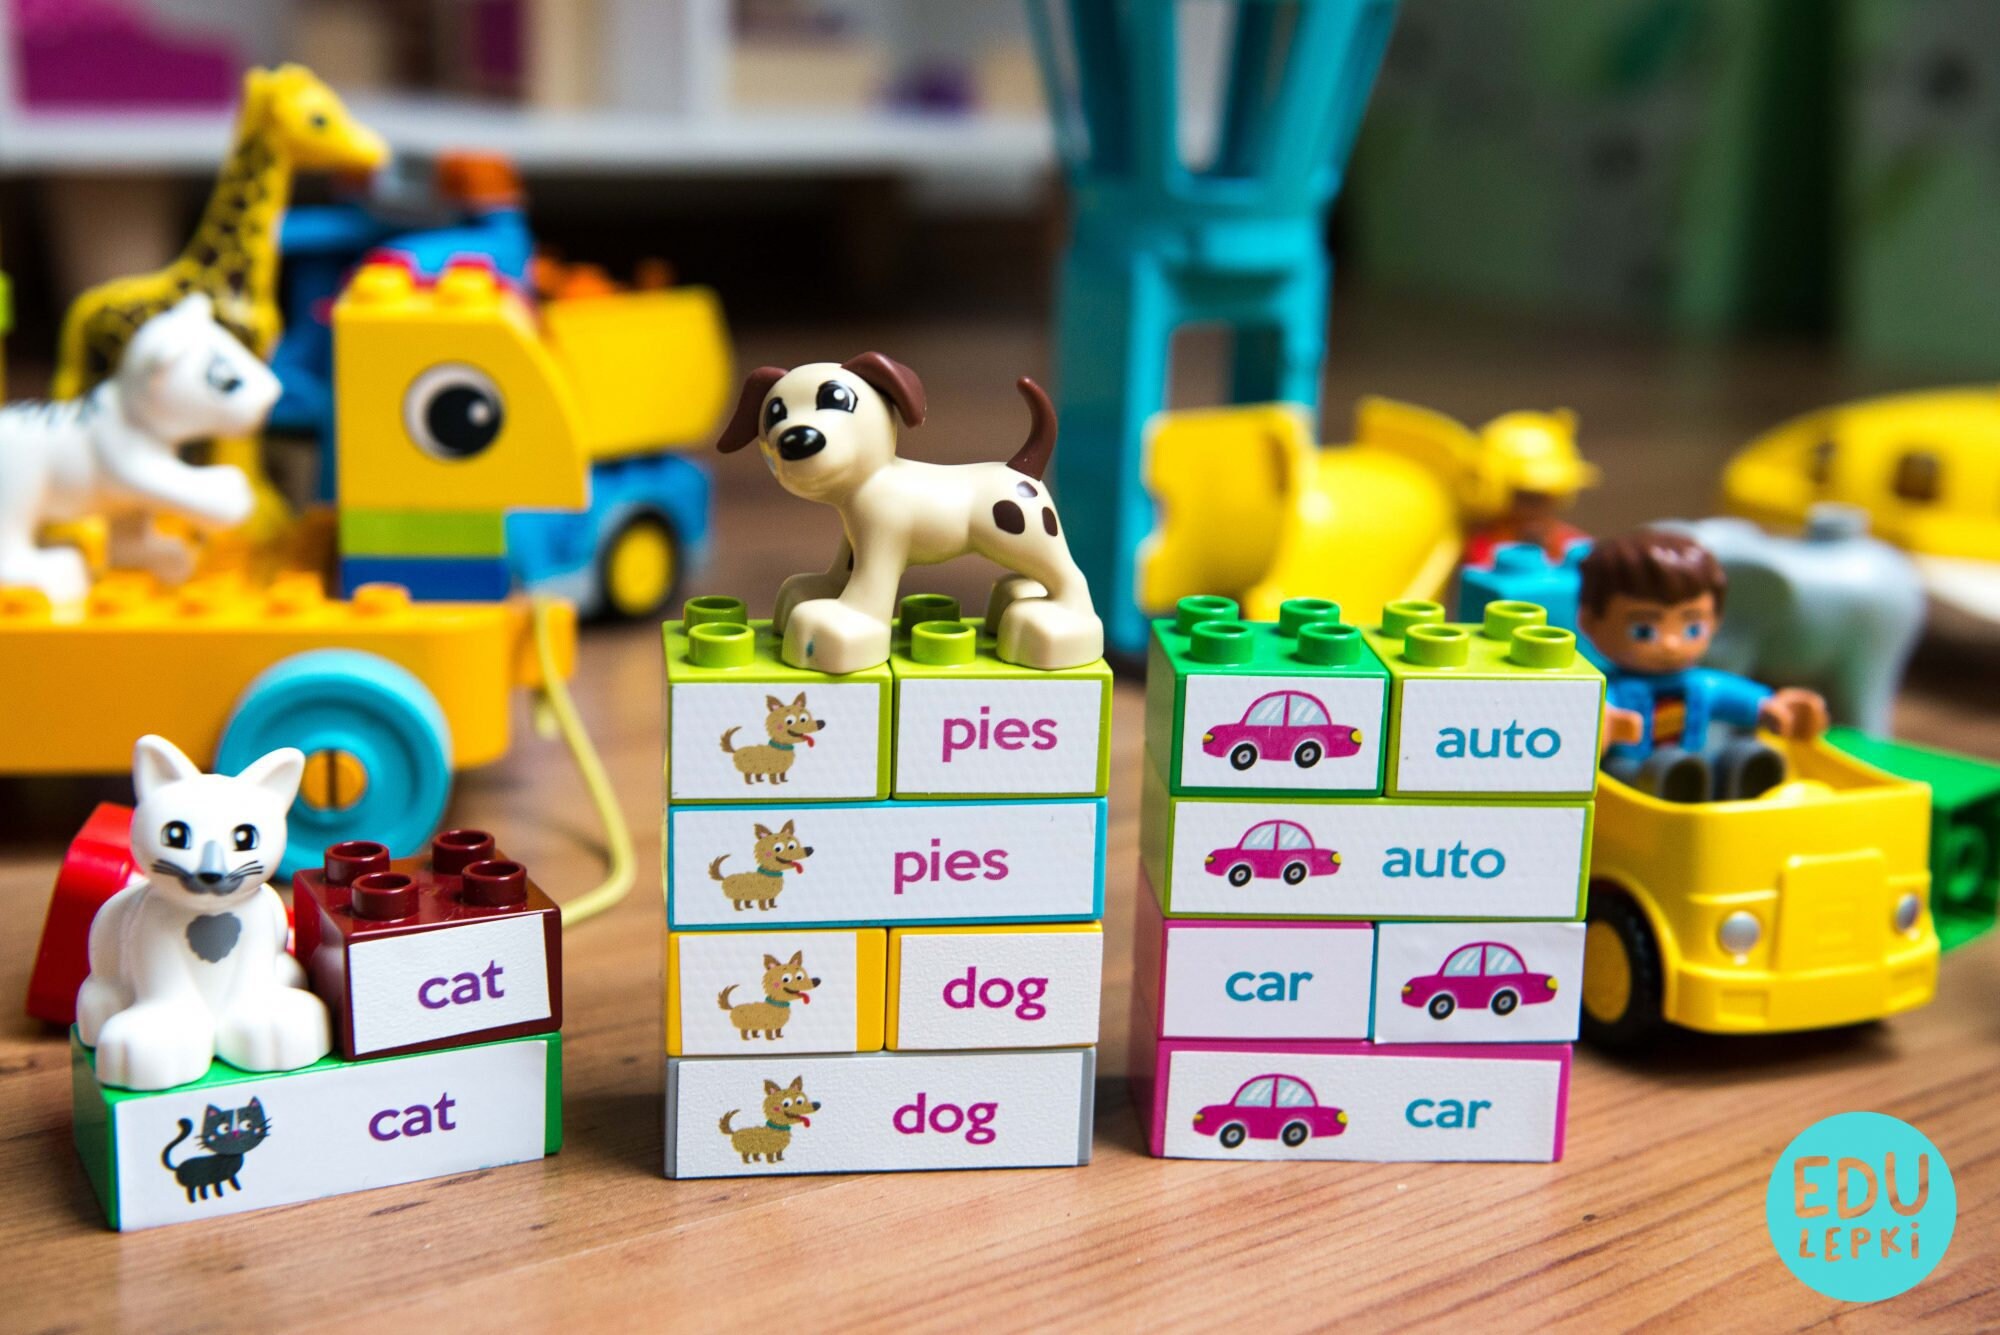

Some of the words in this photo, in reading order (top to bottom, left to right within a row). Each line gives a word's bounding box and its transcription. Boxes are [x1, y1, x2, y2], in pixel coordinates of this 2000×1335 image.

[942, 706, 1057, 763] pies
[1435, 719, 1561, 759] auto
[894, 838, 1009, 895] pies
[1381, 840, 1506, 879] auto
[418, 960, 504, 1009] cat
[942, 966, 1049, 1021] dog
[1224, 970, 1313, 1003] car
[368, 1092, 456, 1141] cat
[892, 1092, 999, 1146] dog
[1404, 1097, 1492, 1129] car
